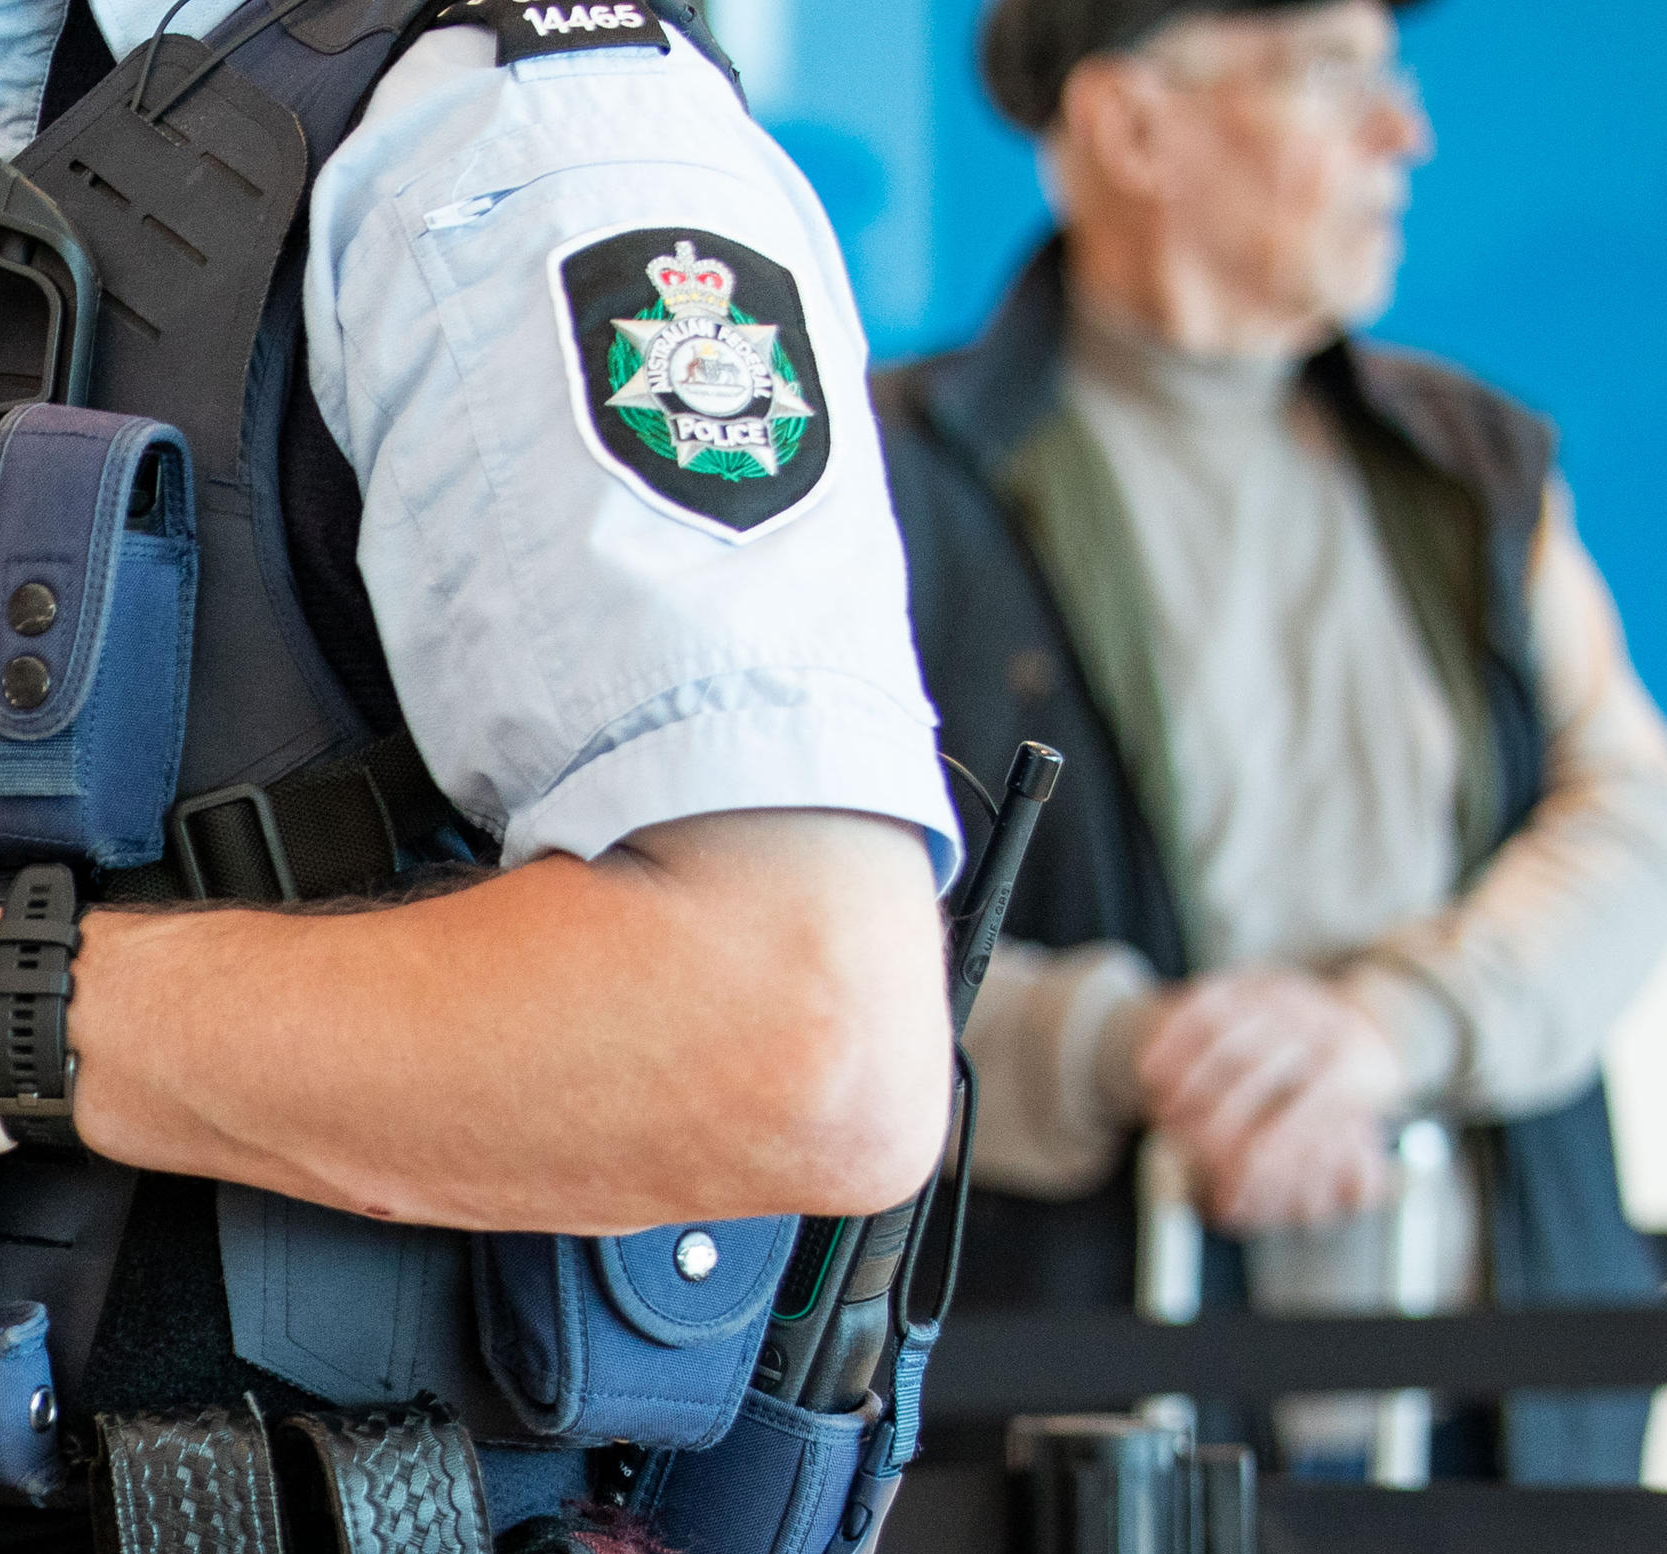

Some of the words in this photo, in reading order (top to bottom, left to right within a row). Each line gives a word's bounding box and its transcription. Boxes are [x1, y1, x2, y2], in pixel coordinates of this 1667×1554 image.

[523, 4, 645, 36] 14465
[647, 318, 716, 393] AUSTRALIAN
[718, 326, 772, 398] FEDERAL
[677, 417, 767, 447] POLICE
